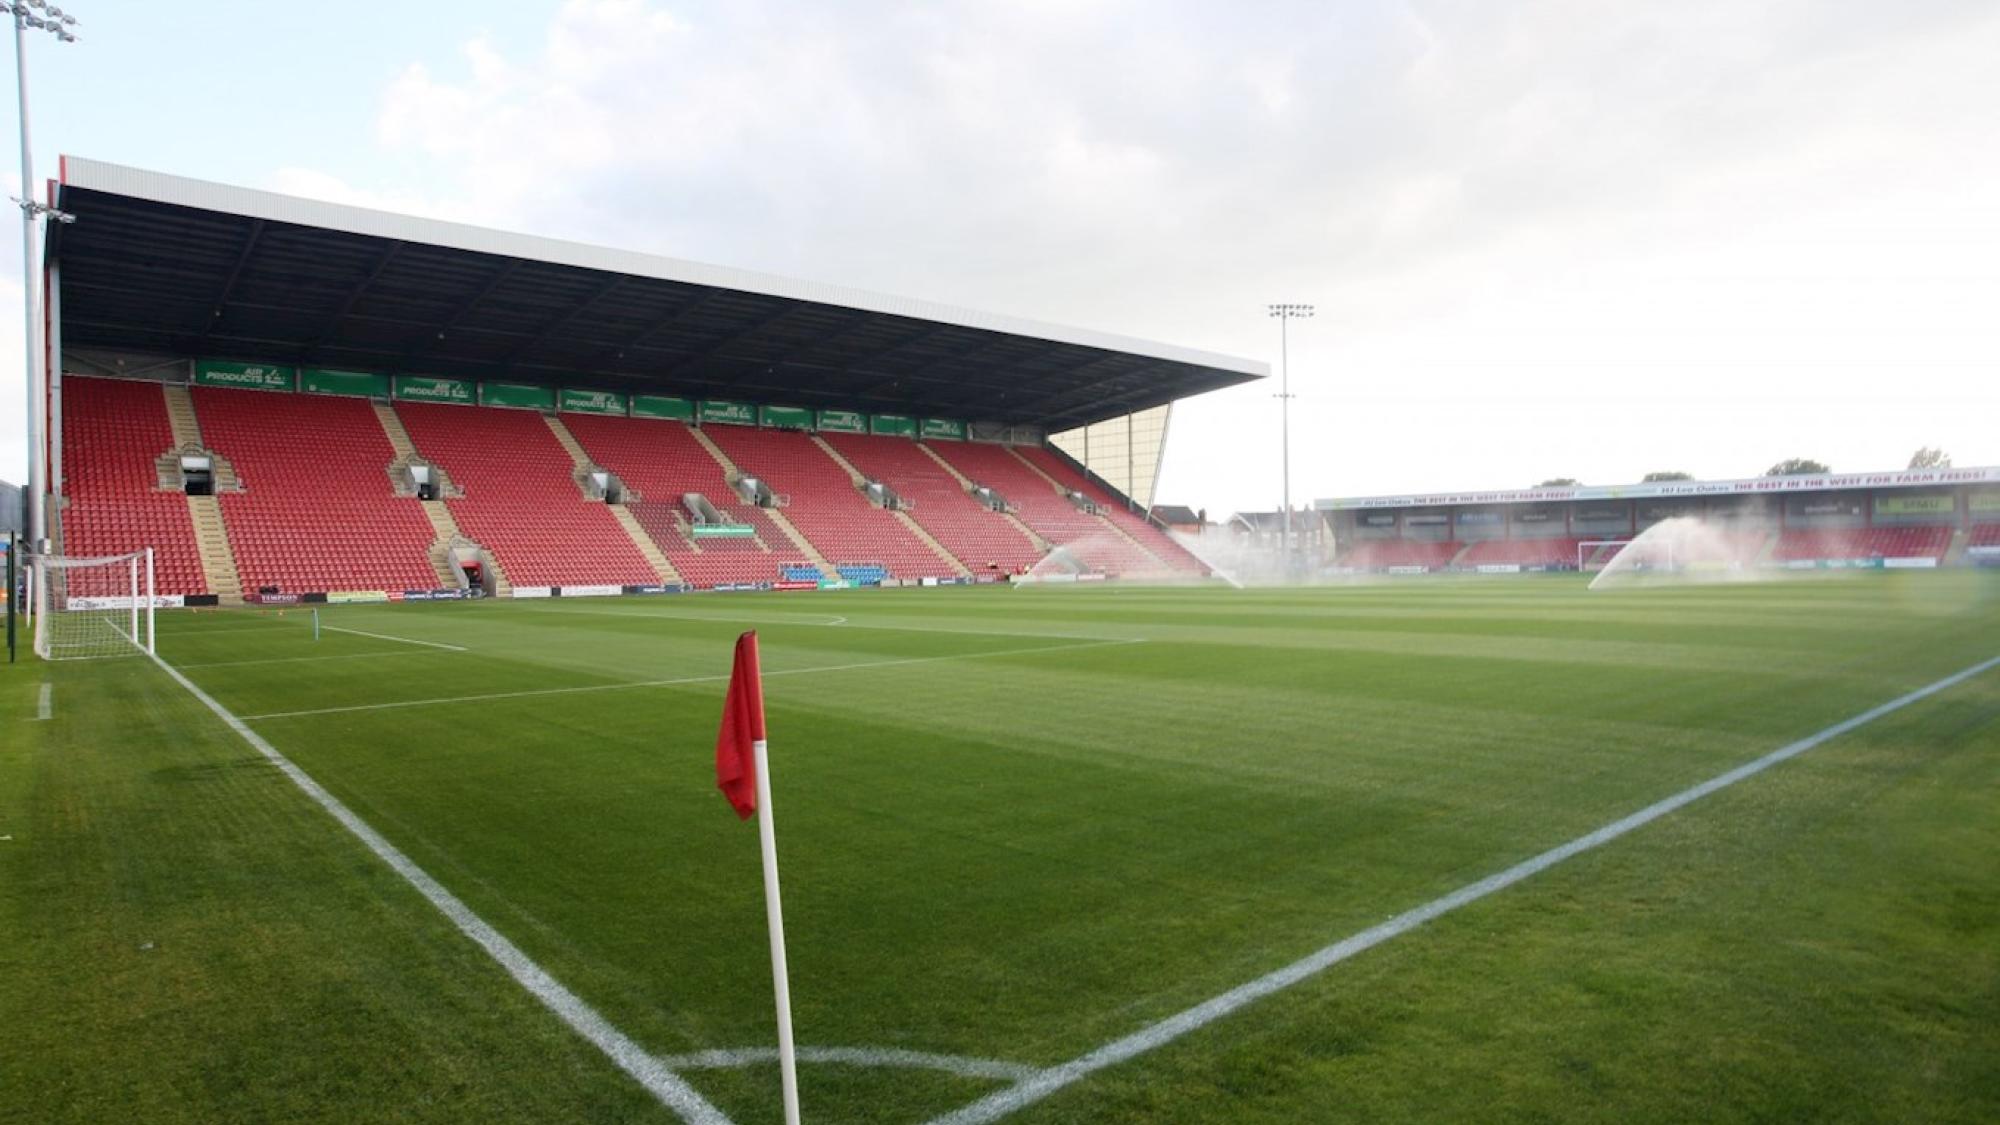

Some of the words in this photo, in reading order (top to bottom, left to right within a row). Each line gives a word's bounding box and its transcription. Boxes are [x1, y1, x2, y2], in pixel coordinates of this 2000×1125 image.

[205, 371, 263, 384] PRODUCTS
[244, 368, 263, 376] AIR
[403, 386, 450, 398] PRODUCTS
[1734, 482, 1753, 490] THE
[1757, 481, 1782, 489] BEST
[1787, 480, 1799, 488] IN
[1805, 479, 1823, 487] THE
[1829, 478, 1861, 486] WEST
[1866, 475, 1891, 484] FOR
[1896, 474, 1934, 483] FARM
